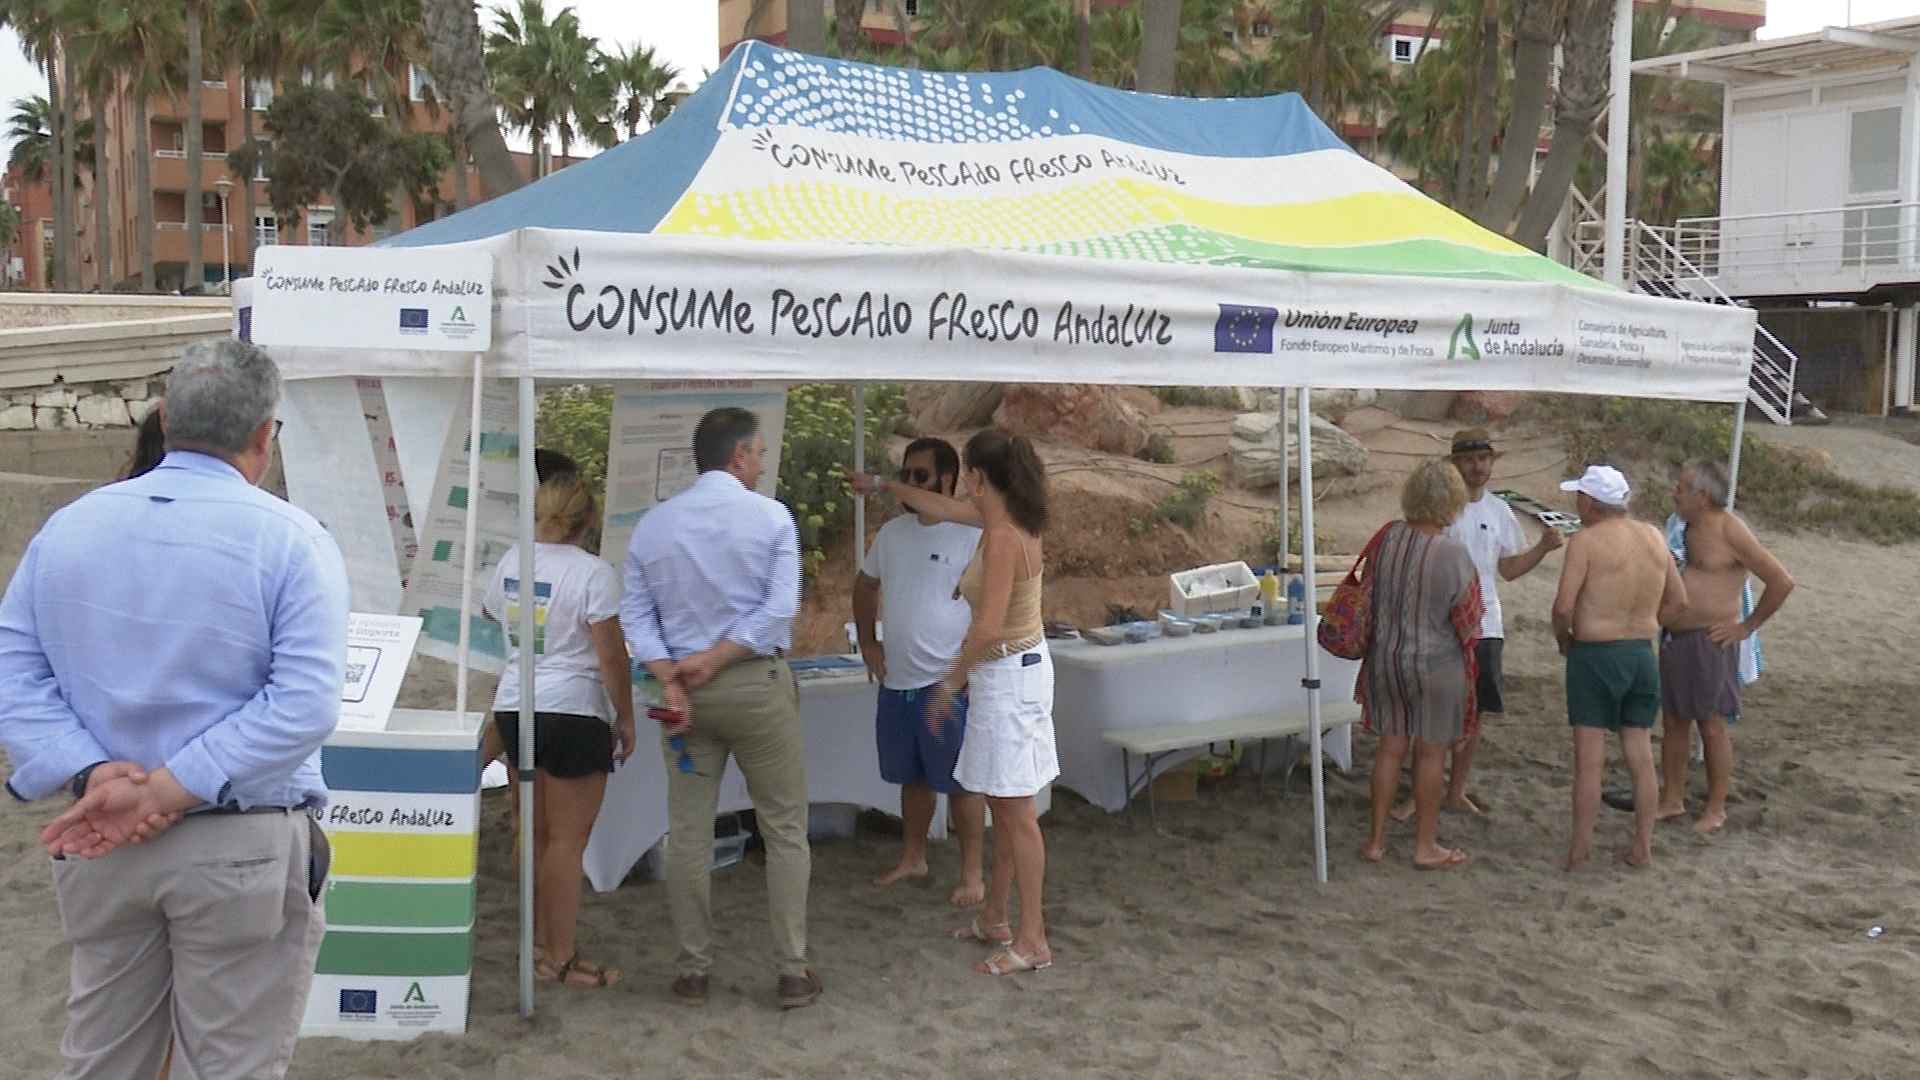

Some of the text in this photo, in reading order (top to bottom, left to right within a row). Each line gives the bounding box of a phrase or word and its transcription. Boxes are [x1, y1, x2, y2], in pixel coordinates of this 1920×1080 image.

[1284, 308, 1419, 338] Unión Europea
[1483, 318, 1520, 336] Junta
[1280, 338, 1311, 352] Fondo
[1312, 340, 1349, 355] Europeo
[1391, 346, 1397, 357] y
[1398, 344, 1409, 356] de
[1484, 337, 1564, 358] de Andalucía
